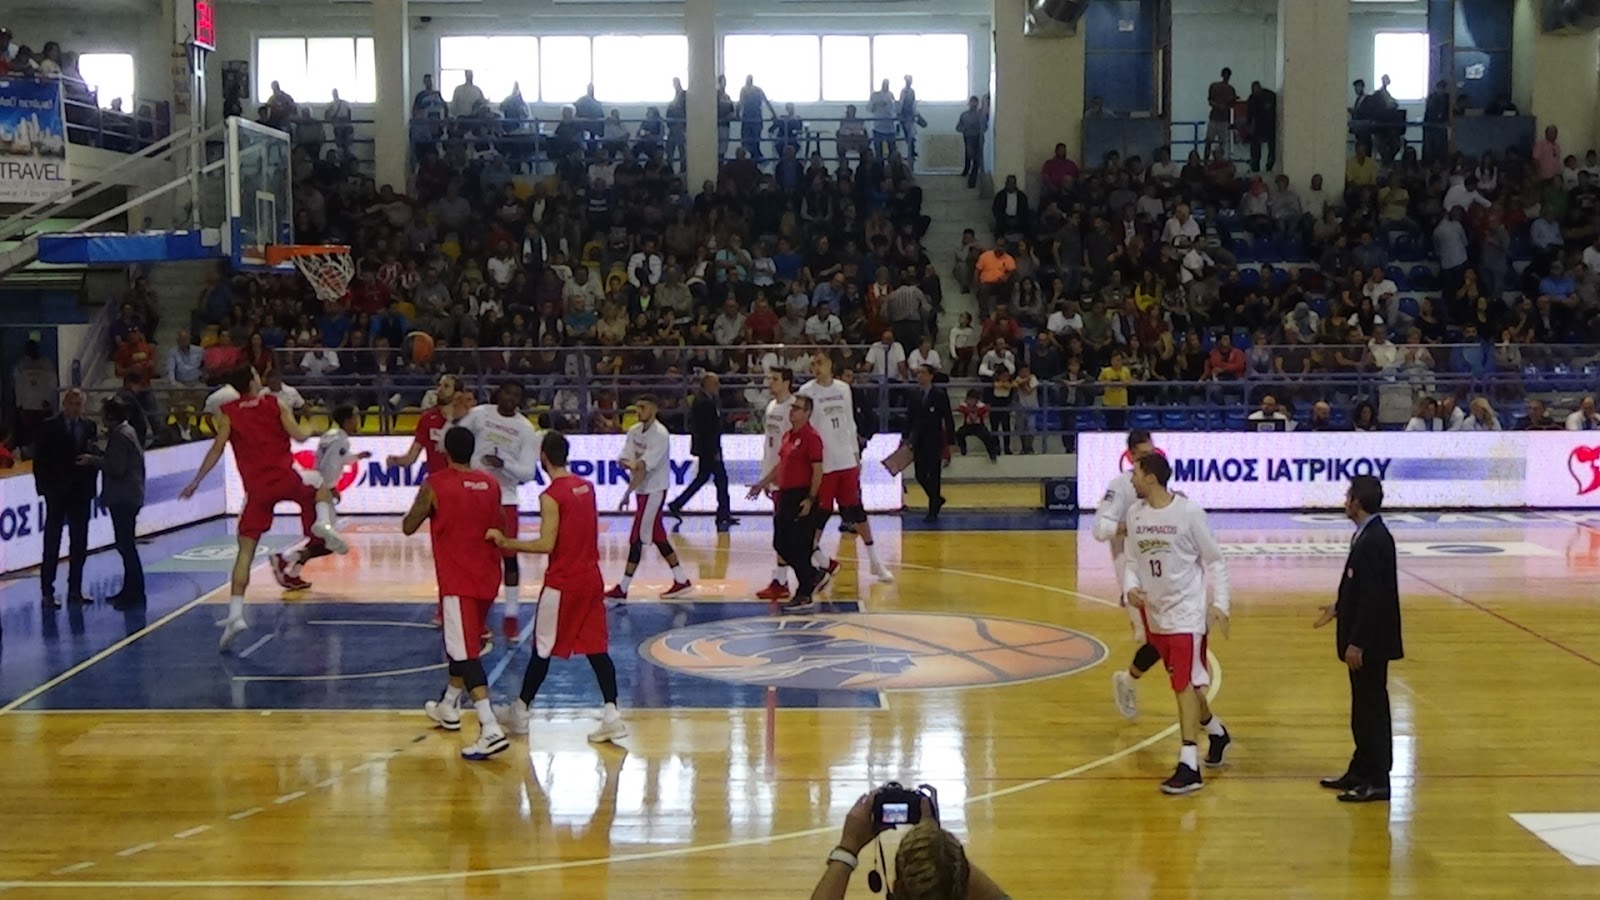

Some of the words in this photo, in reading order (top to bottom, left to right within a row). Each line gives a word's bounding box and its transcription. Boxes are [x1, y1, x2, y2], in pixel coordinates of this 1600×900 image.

[0, 161, 66, 181] TRAVEL
[1136, 525, 1178, 535] OLYMPIACOS
[1149, 559, 1162, 578] 13
